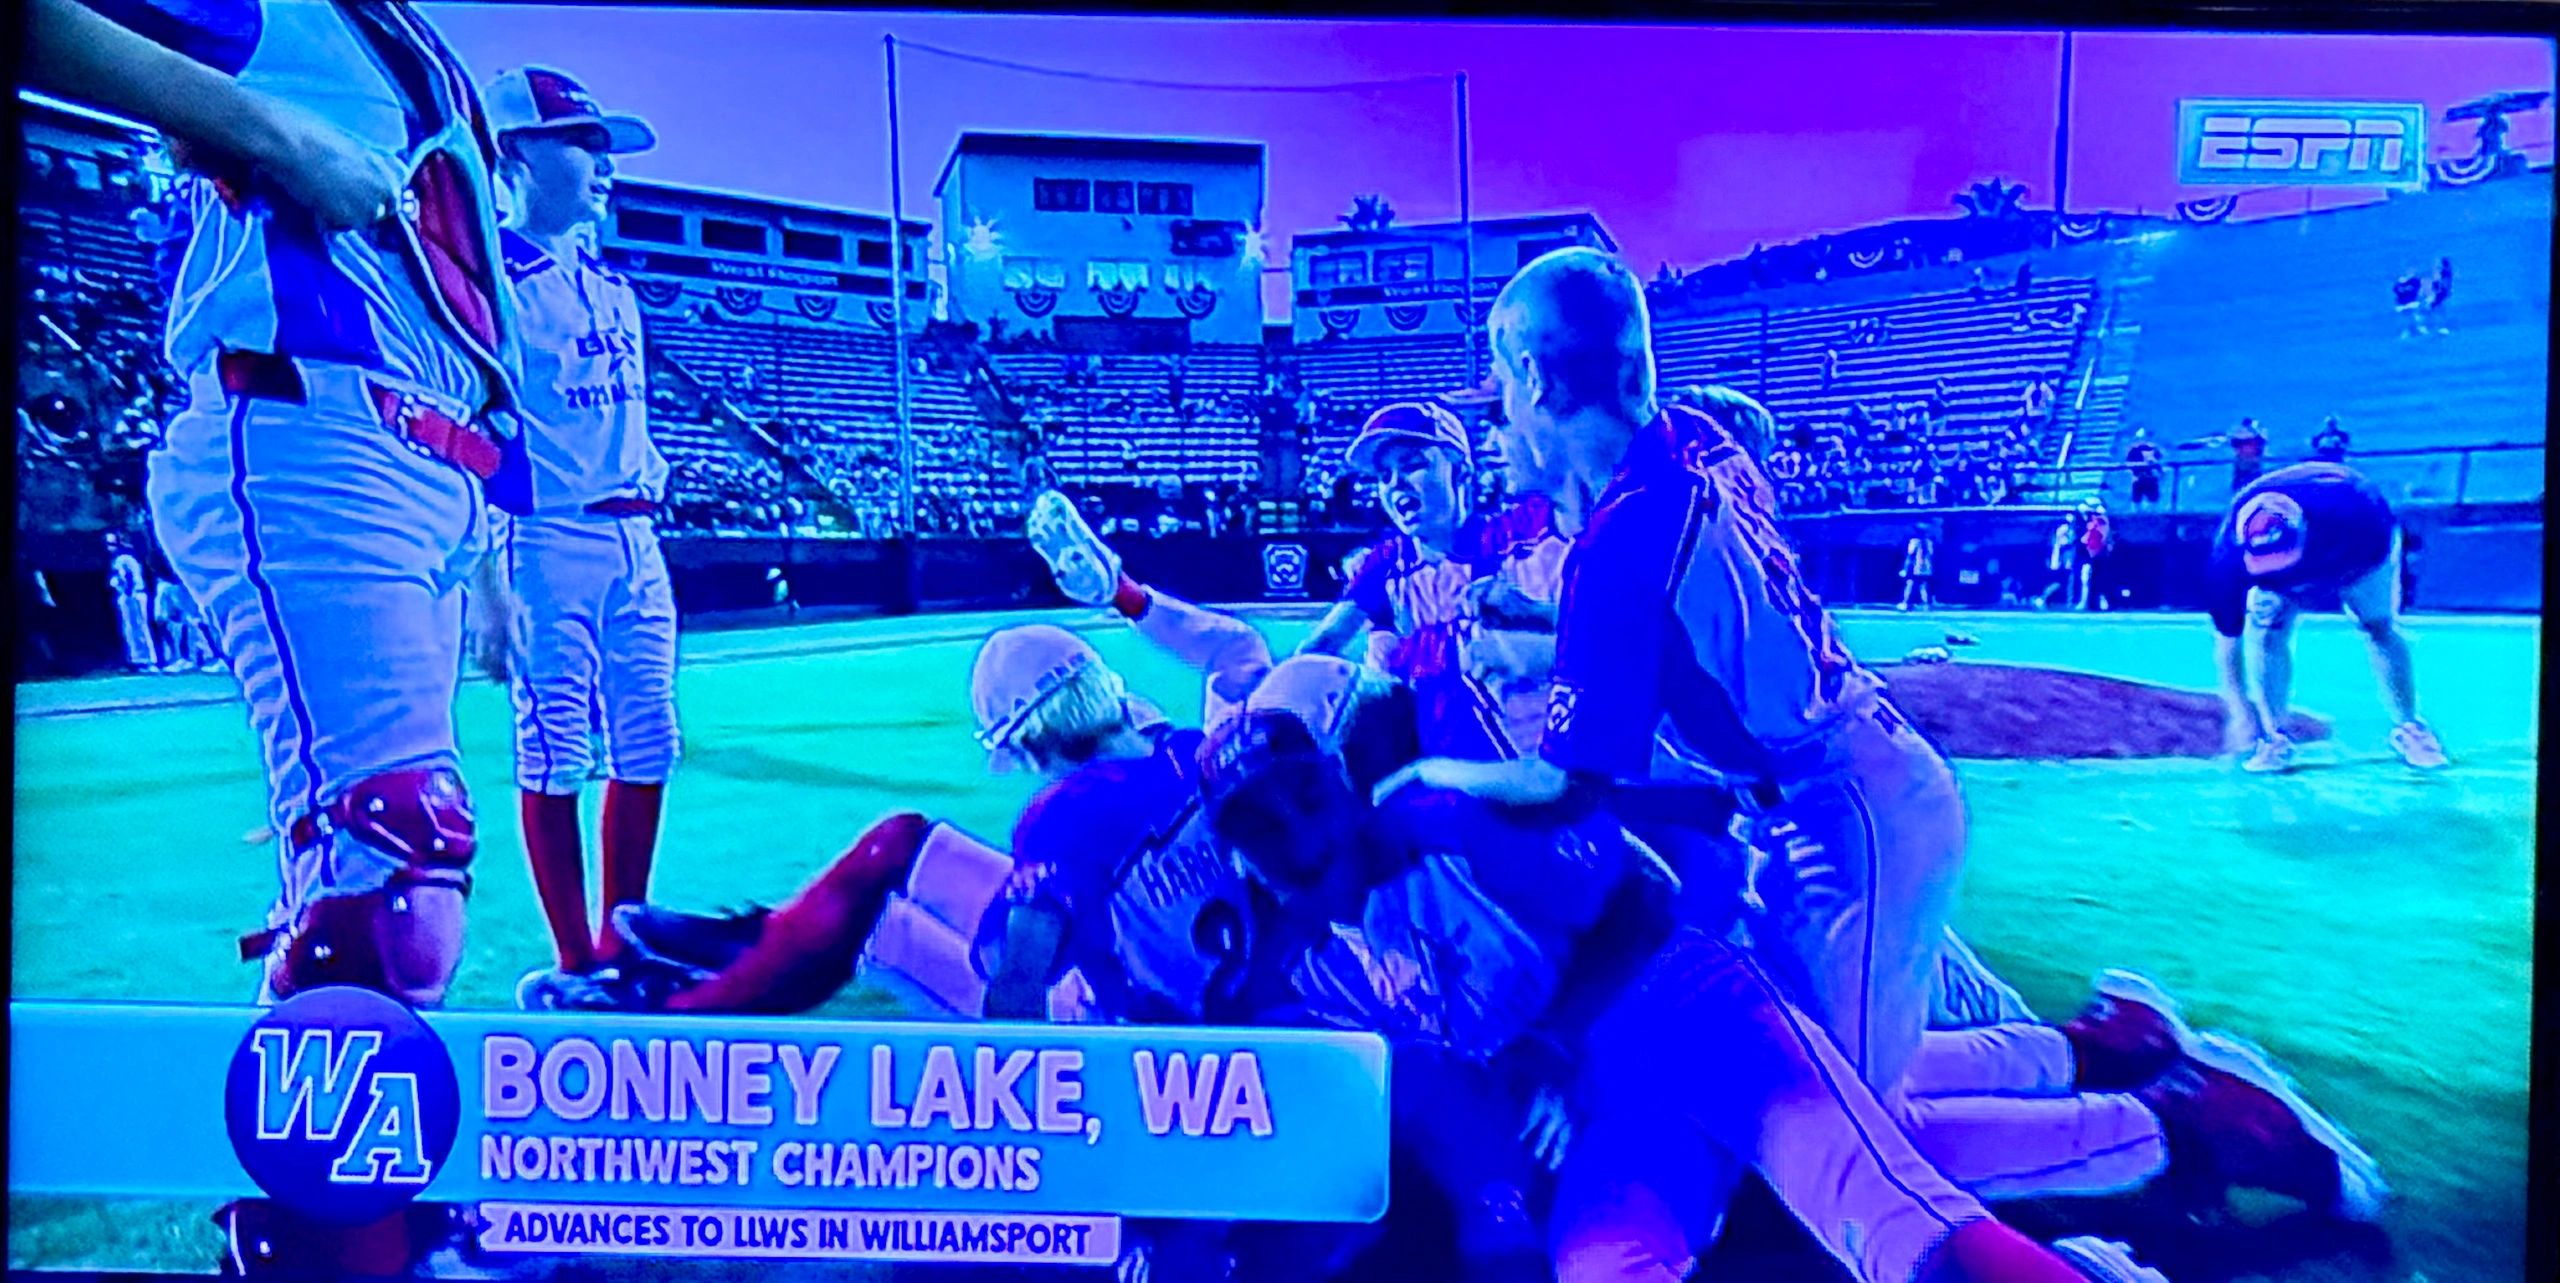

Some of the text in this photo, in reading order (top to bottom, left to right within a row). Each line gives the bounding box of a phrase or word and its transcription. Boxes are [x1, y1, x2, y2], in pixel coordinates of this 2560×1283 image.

[2199, 116, 2405, 171] ESPN
[252, 1027, 433, 1184] WA
[483, 1035, 1273, 1145] BONNEY LAKE, WA
[480, 1133, 1042, 1192] NORTHWEST CHAMPIONS
[504, 1211, 1092, 1256] ADVANCES TO LLWS IN WILLIAMSPORT
